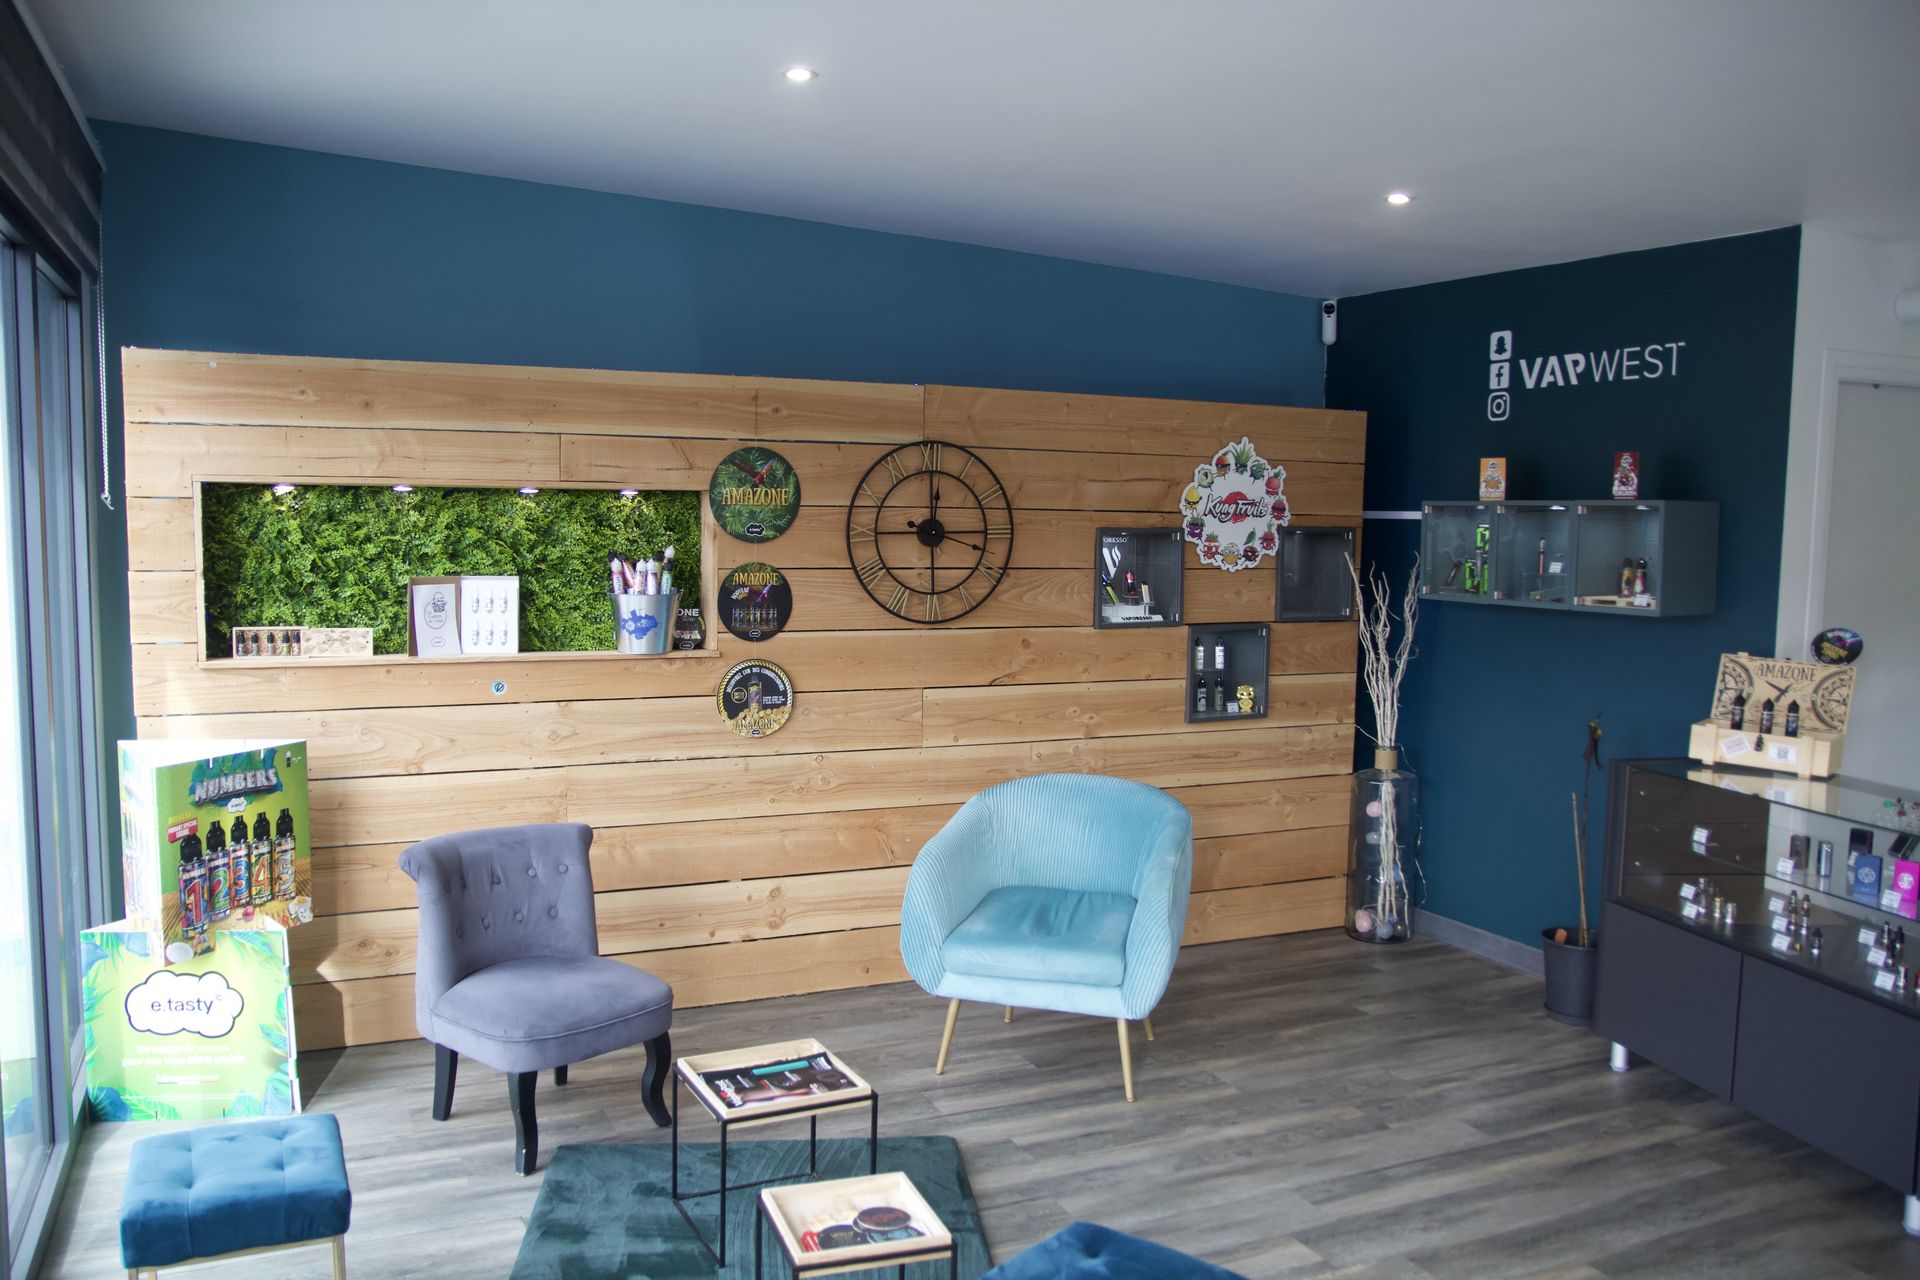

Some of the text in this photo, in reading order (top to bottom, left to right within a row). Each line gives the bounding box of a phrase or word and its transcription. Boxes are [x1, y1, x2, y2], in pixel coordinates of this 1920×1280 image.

[721, 487, 789, 506] AMAZONE
[1203, 494, 1268, 523] Kung Fruits
[732, 572, 779, 585] AMAZONE
[1755, 663, 1819, 681] AMAZONE
[735, 718, 776, 730] AMAZONE
[194, 767, 278, 802] NUMBERS
[210, 867, 230, 908] 2
[234, 859, 250, 897] 3
[254, 855, 271, 894] 4
[278, 853, 295, 893] 5
[185, 878, 202, 925] 1
